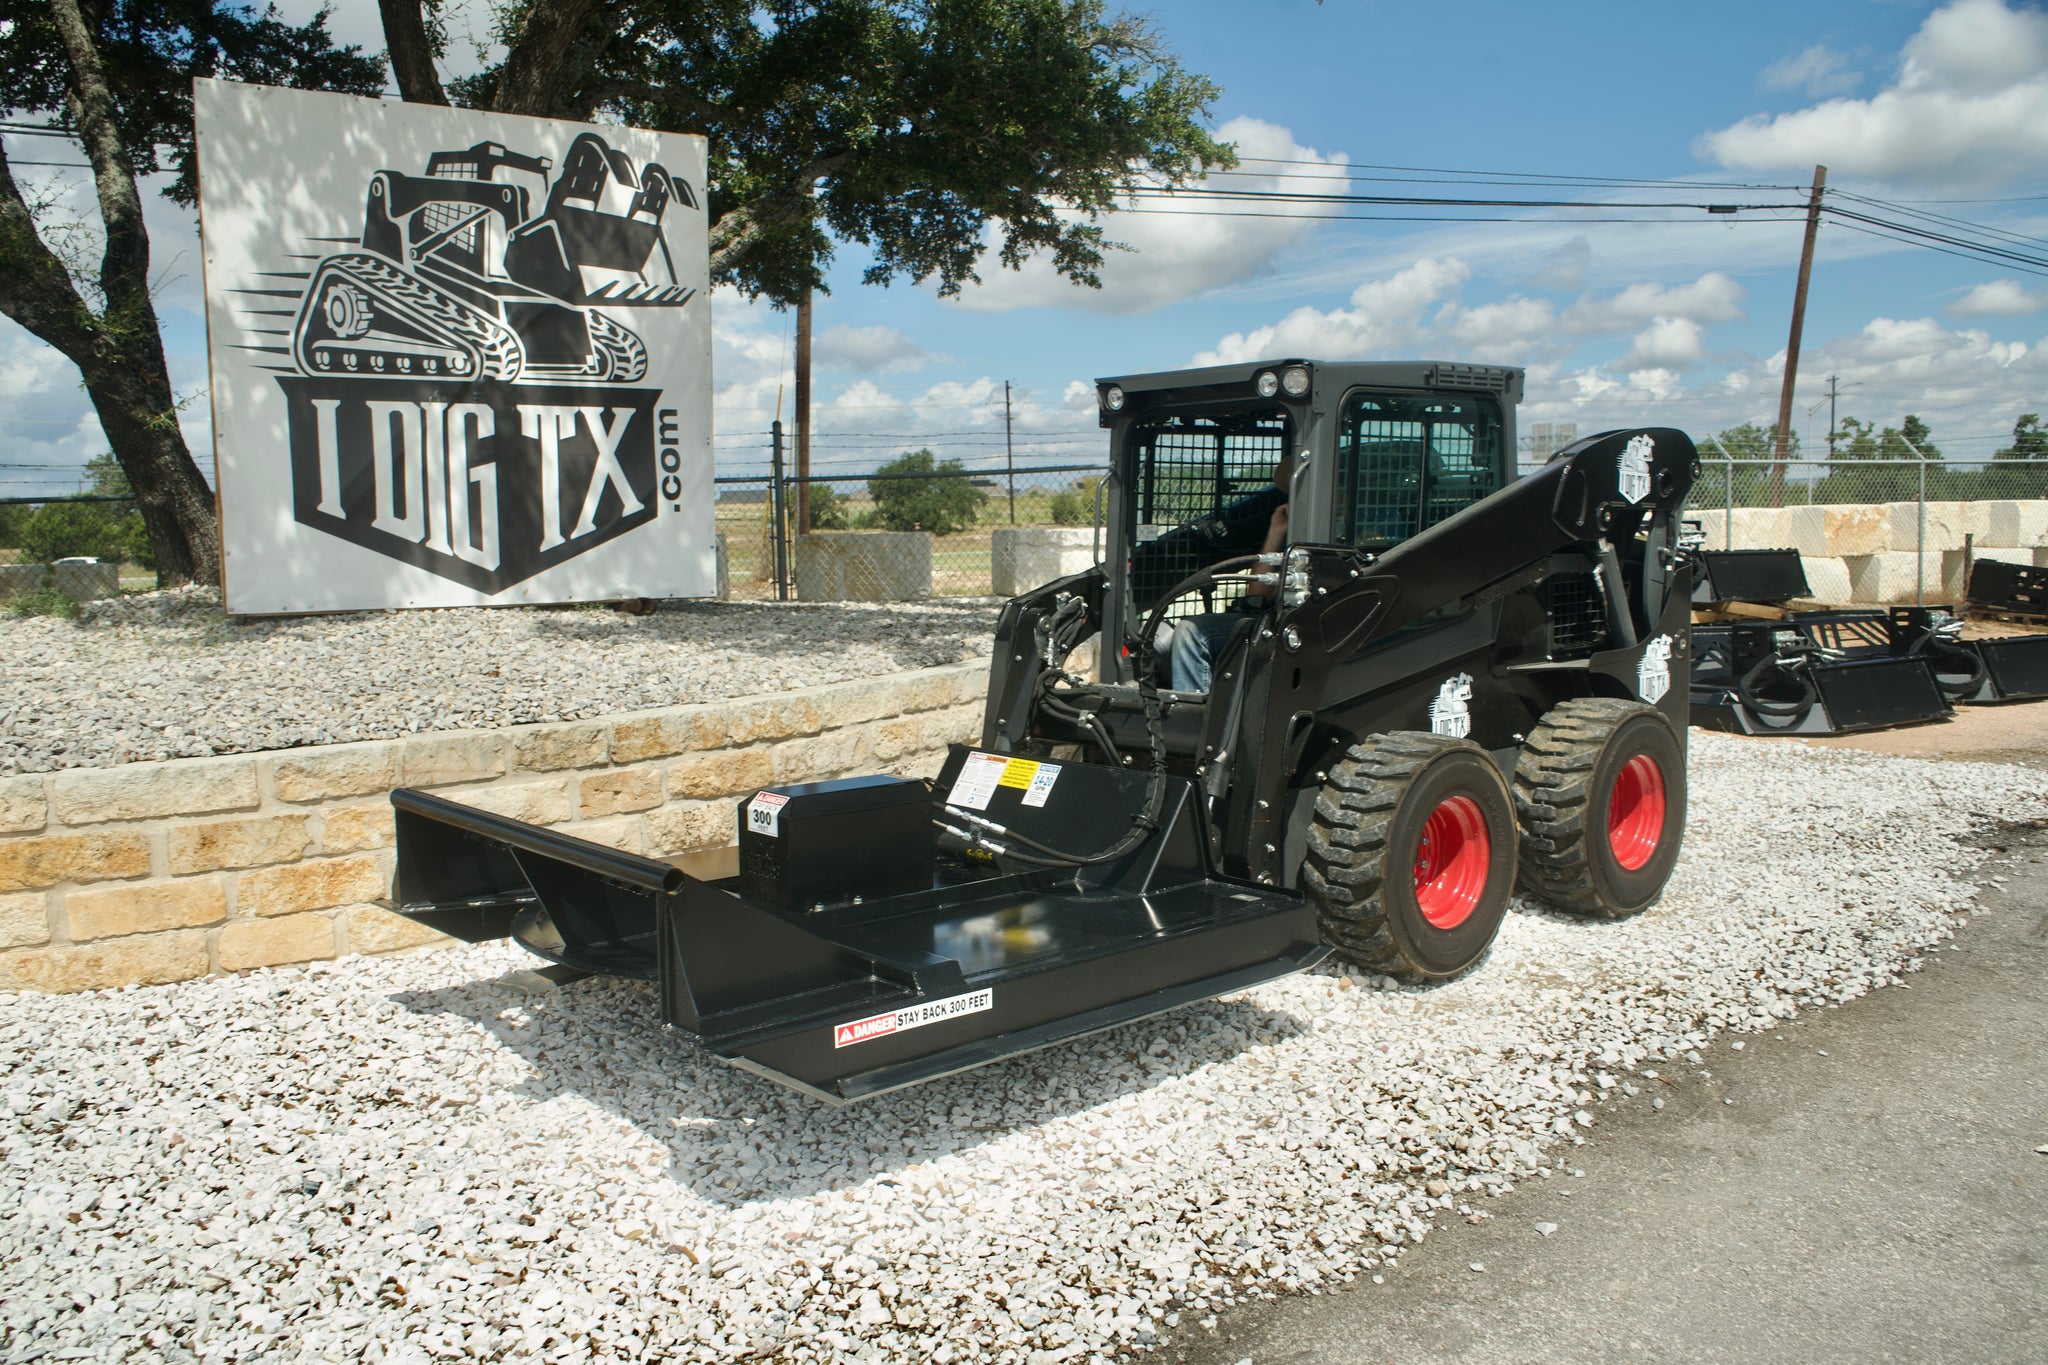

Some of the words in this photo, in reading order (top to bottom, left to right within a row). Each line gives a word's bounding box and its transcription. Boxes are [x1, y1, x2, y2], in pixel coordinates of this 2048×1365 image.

[310, 398, 347, 520] I
[366, 399, 502, 573] DIG
[515, 403, 646, 554] TX
[659, 408, 680, 513] .com
[753, 809, 771, 826] 300
[853, 1015, 896, 1039] DANGER
[897, 1012, 919, 1027] STAY
[922, 1003, 947, 1020] BACK
[949, 999, 967, 1014] 300
[968, 993, 989, 1009] FEET
